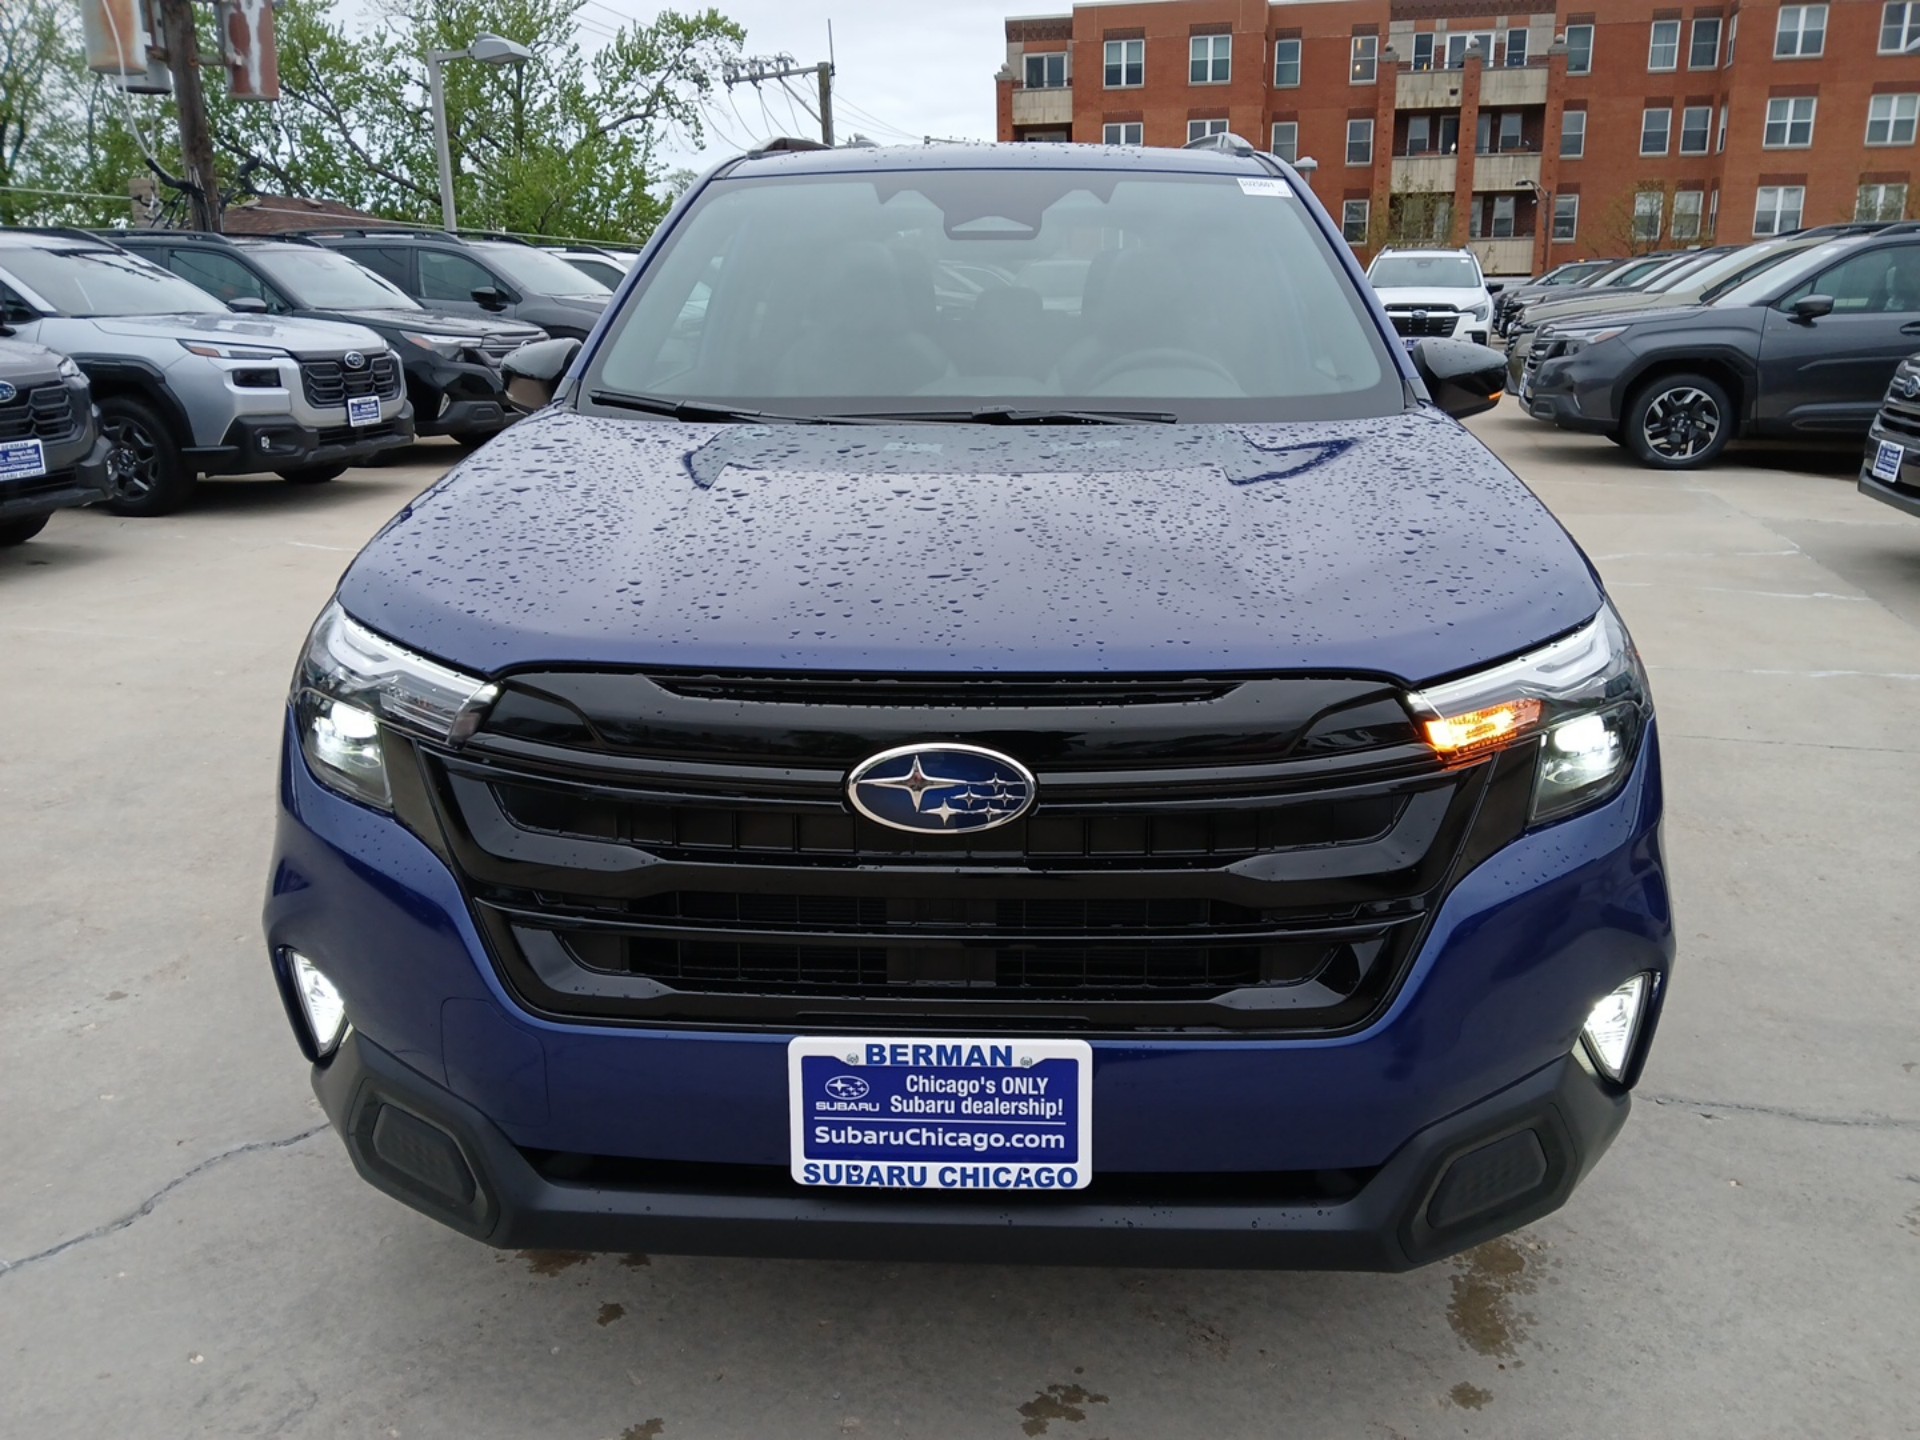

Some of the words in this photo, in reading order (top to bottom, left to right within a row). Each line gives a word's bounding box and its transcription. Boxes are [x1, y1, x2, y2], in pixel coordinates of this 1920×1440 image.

[865, 1043, 1012, 1066] BERMAN
[905, 1074, 996, 1096] Chicago's
[1001, 1077, 1048, 1095] ONLY
[815, 1100, 880, 1112] SUBARU
[890, 1095, 955, 1114] Subaru
[961, 1097, 1064, 1119] dealership!
[814, 1126, 1065, 1151] SubaruChicago.com
[803, 1163, 927, 1186] SUBARU
[938, 1167, 1078, 1188] CHICAGO
